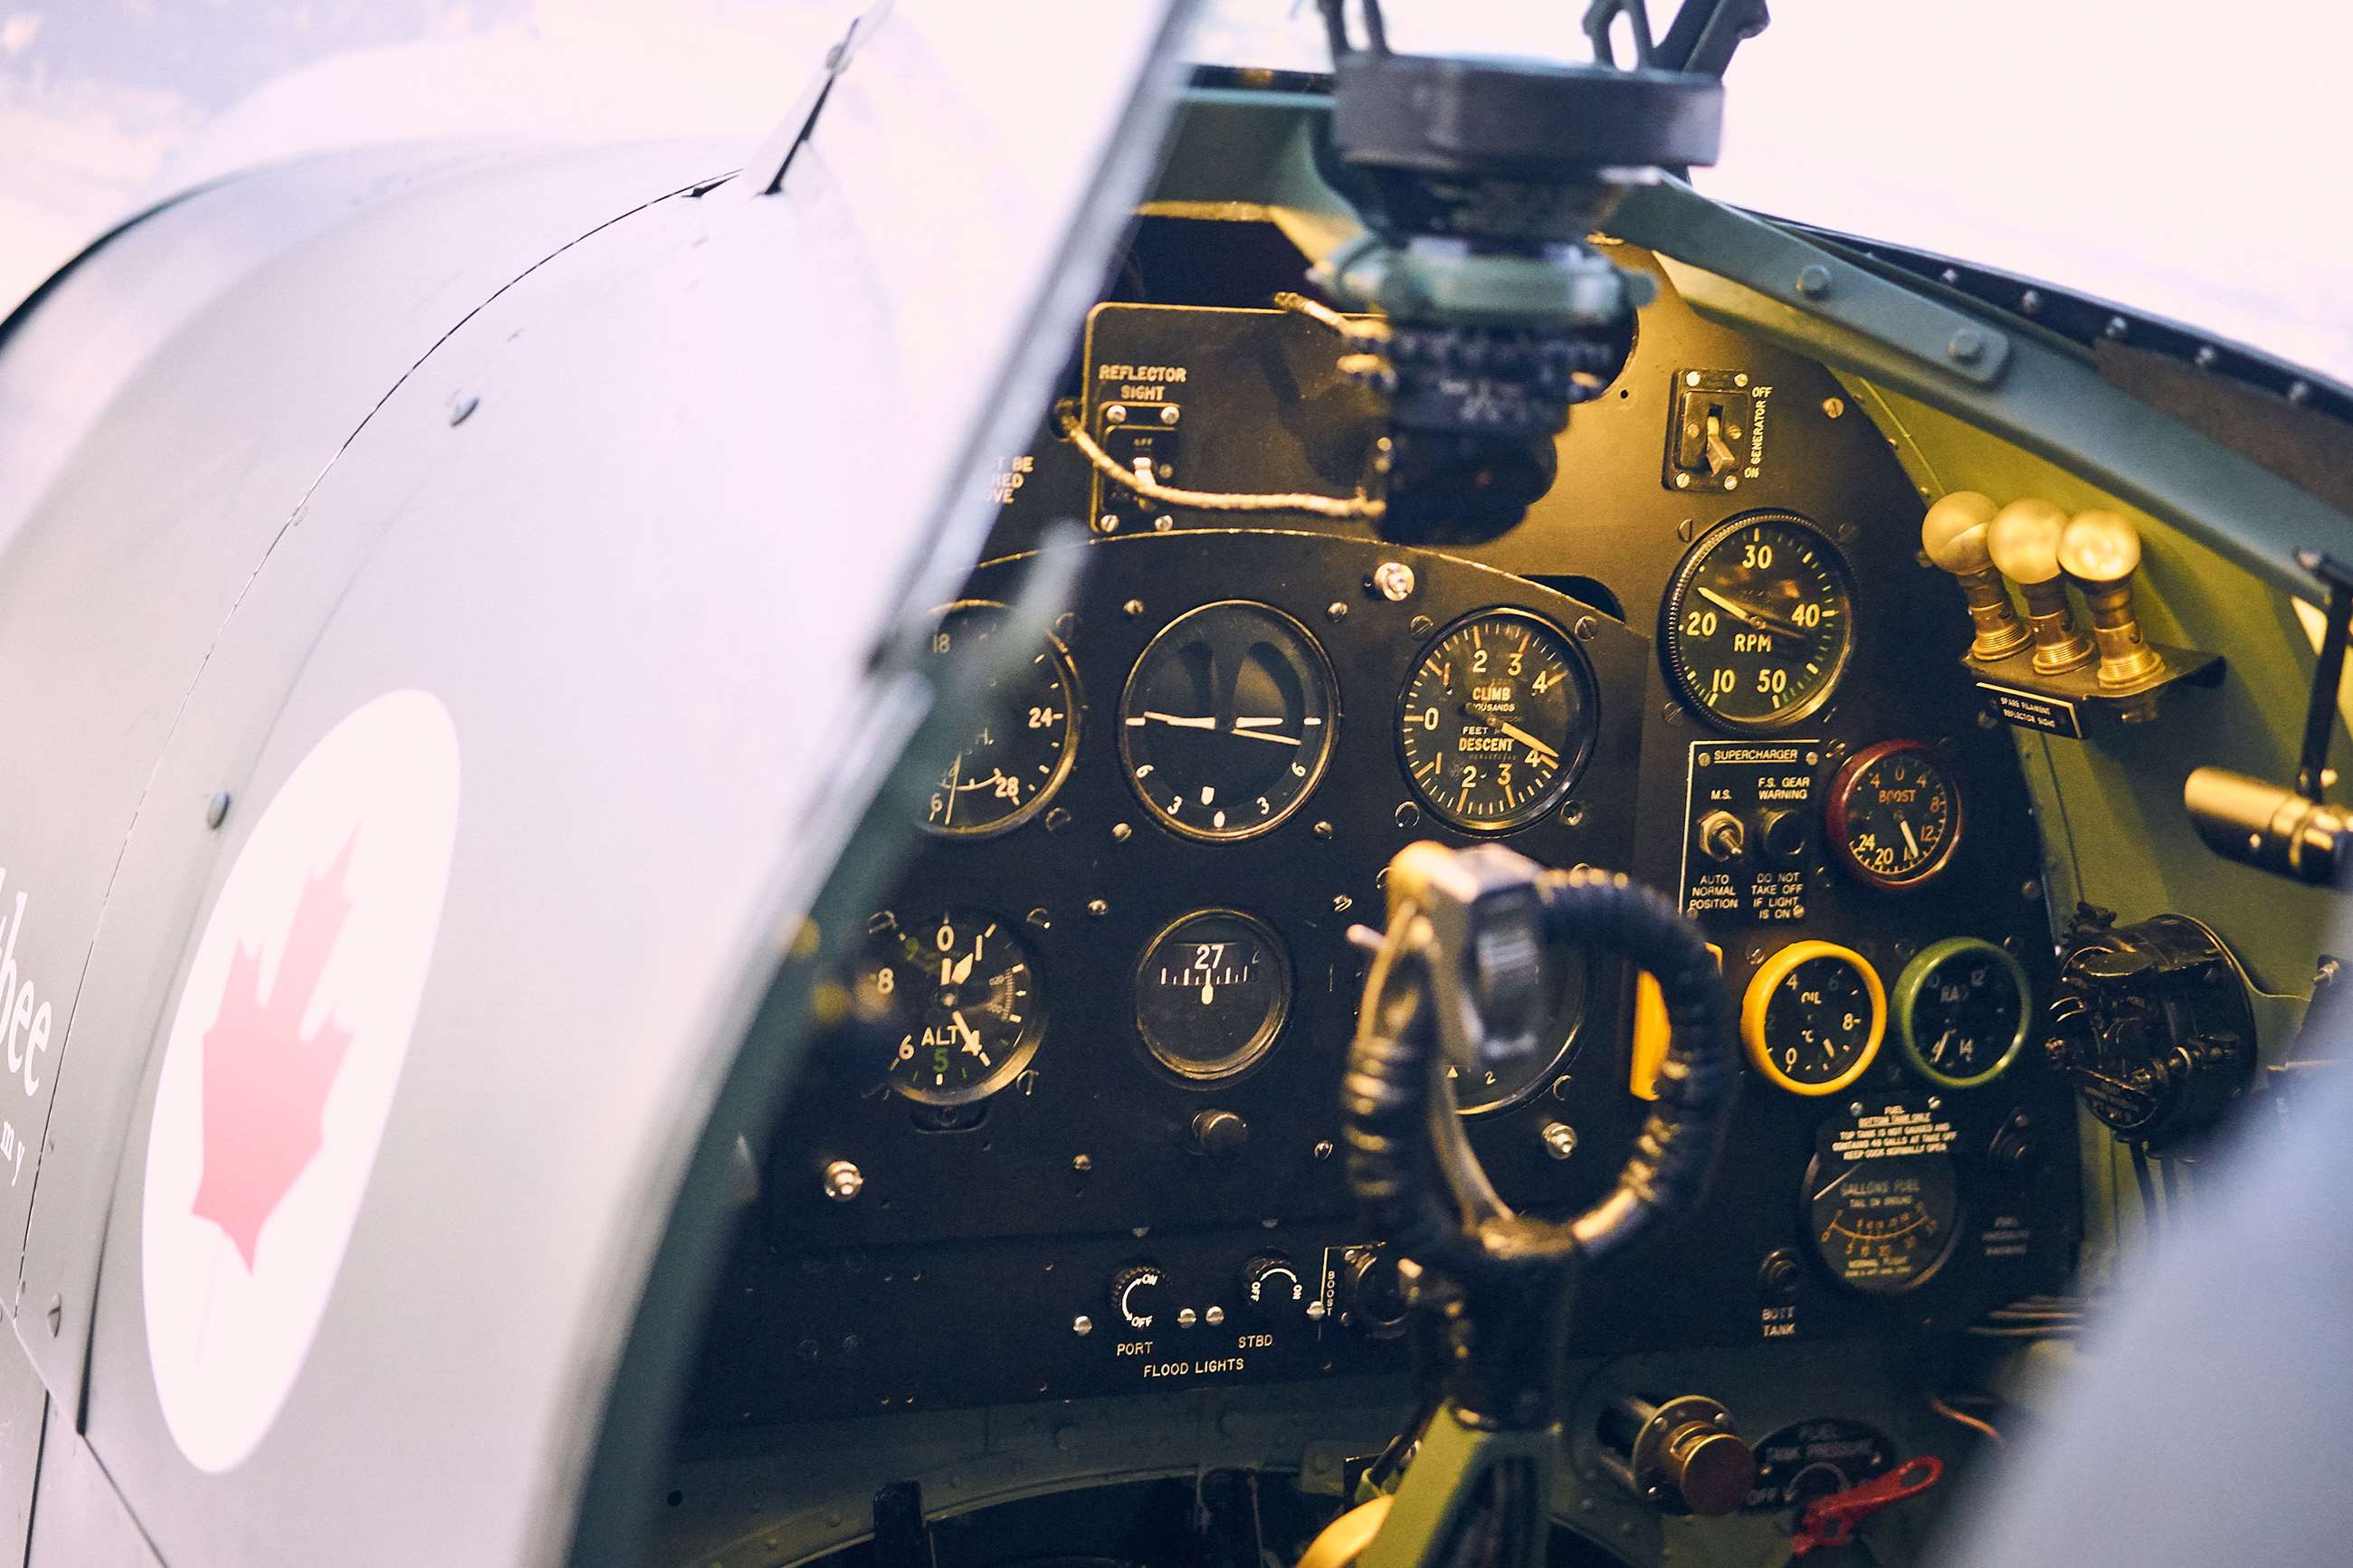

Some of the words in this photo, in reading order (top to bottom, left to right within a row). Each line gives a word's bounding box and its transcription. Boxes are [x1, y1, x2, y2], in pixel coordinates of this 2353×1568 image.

[1099, 365, 1186, 382] REFLECTOR
[1120, 385, 1166, 401] SIGHT
[1751, 386, 1773, 398] OFF
[1750, 401, 1766, 464] GENERATOR
[1744, 467, 1759, 479] ON
[1742, 545, 1773, 569] 30
[1791, 603, 1820, 627] 40
[1687, 611, 1717, 637] 20
[1734, 633, 1773, 652] RPM
[1472, 650, 1488, 673] 2
[1508, 653, 1522, 676] 3
[1532, 670, 1548, 693] 4
[1712, 669, 1736, 693] 10
[1757, 669, 1786, 694] 50
[1472, 687, 1511, 701] CLIMB
[1028, 707, 1053, 728] 24
[1424, 707, 1439, 730] 0
[1462, 727, 1489, 735] FEET
[1459, 737, 1515, 752] DESCENT
[1525, 749, 1540, 767] 4
[1714, 750, 1797, 761] SUPERCHARGER
[1291, 762, 1306, 777] 6
[1462, 765, 1478, 788] 2
[1497, 763, 1512, 785] 3
[1895, 767, 1905, 782] 0
[996, 776, 1019, 797] 28
[1758, 777, 1777, 787] F.S.
[1782, 777, 1810, 788] GEAR
[1870, 773, 1881, 788] 4
[1916, 774, 1927, 788] 4
[1710, 790, 1732, 800] M.S.
[1758, 789, 1808, 800] WARNING
[1879, 789, 1917, 803] BOOST
[1167, 796, 1183, 815] 3
[1256, 796, 1270, 815] 3
[1920, 825, 1935, 841] 12
[1859, 834, 1876, 851] 24
[1875, 848, 1894, 865] 20
[1700, 875, 1729, 884] AUTO
[1757, 873, 1773, 883] DO
[1778, 872, 1801, 883] NOT
[1691, 886, 1737, 897] NORMAL
[1751, 885, 1777, 895] TAKE
[1782, 884, 1804, 894] OFF
[1689, 898, 1738, 909] POSITION
[1752, 898, 1764, 908] IF
[1768, 896, 1799, 907] LIGHT
[1759, 909, 1769, 919] IS
[1774, 908, 1791, 919] ON
[937, 925, 955, 951] 0
[1195, 945, 1224, 969] 27
[878, 967, 894, 993] 8
[1786, 974, 1798, 990] 4
[1801, 992, 1822, 1004] OIL
[1843, 1012, 1853, 1031] 8
[921, 1026, 959, 1046] ALT
[899, 1034, 914, 1060] 6
[934, 1047, 948, 1073] 5
[1786, 1047, 1797, 1065] 0
[1142, 1274, 1158, 1286] ON
[1251, 1281, 1261, 1302] OFF
[1292, 1284, 1302, 1300] ON
[1327, 1270, 1335, 1316] BOOST
[1131, 1316, 1153, 1327] OFF
[1117, 1342, 1153, 1356] PORT
[1238, 1334, 1273, 1349] STBD
[1143, 1363, 1189, 1378] FLOOD
[1195, 1358, 1244, 1374] LIGHTS
